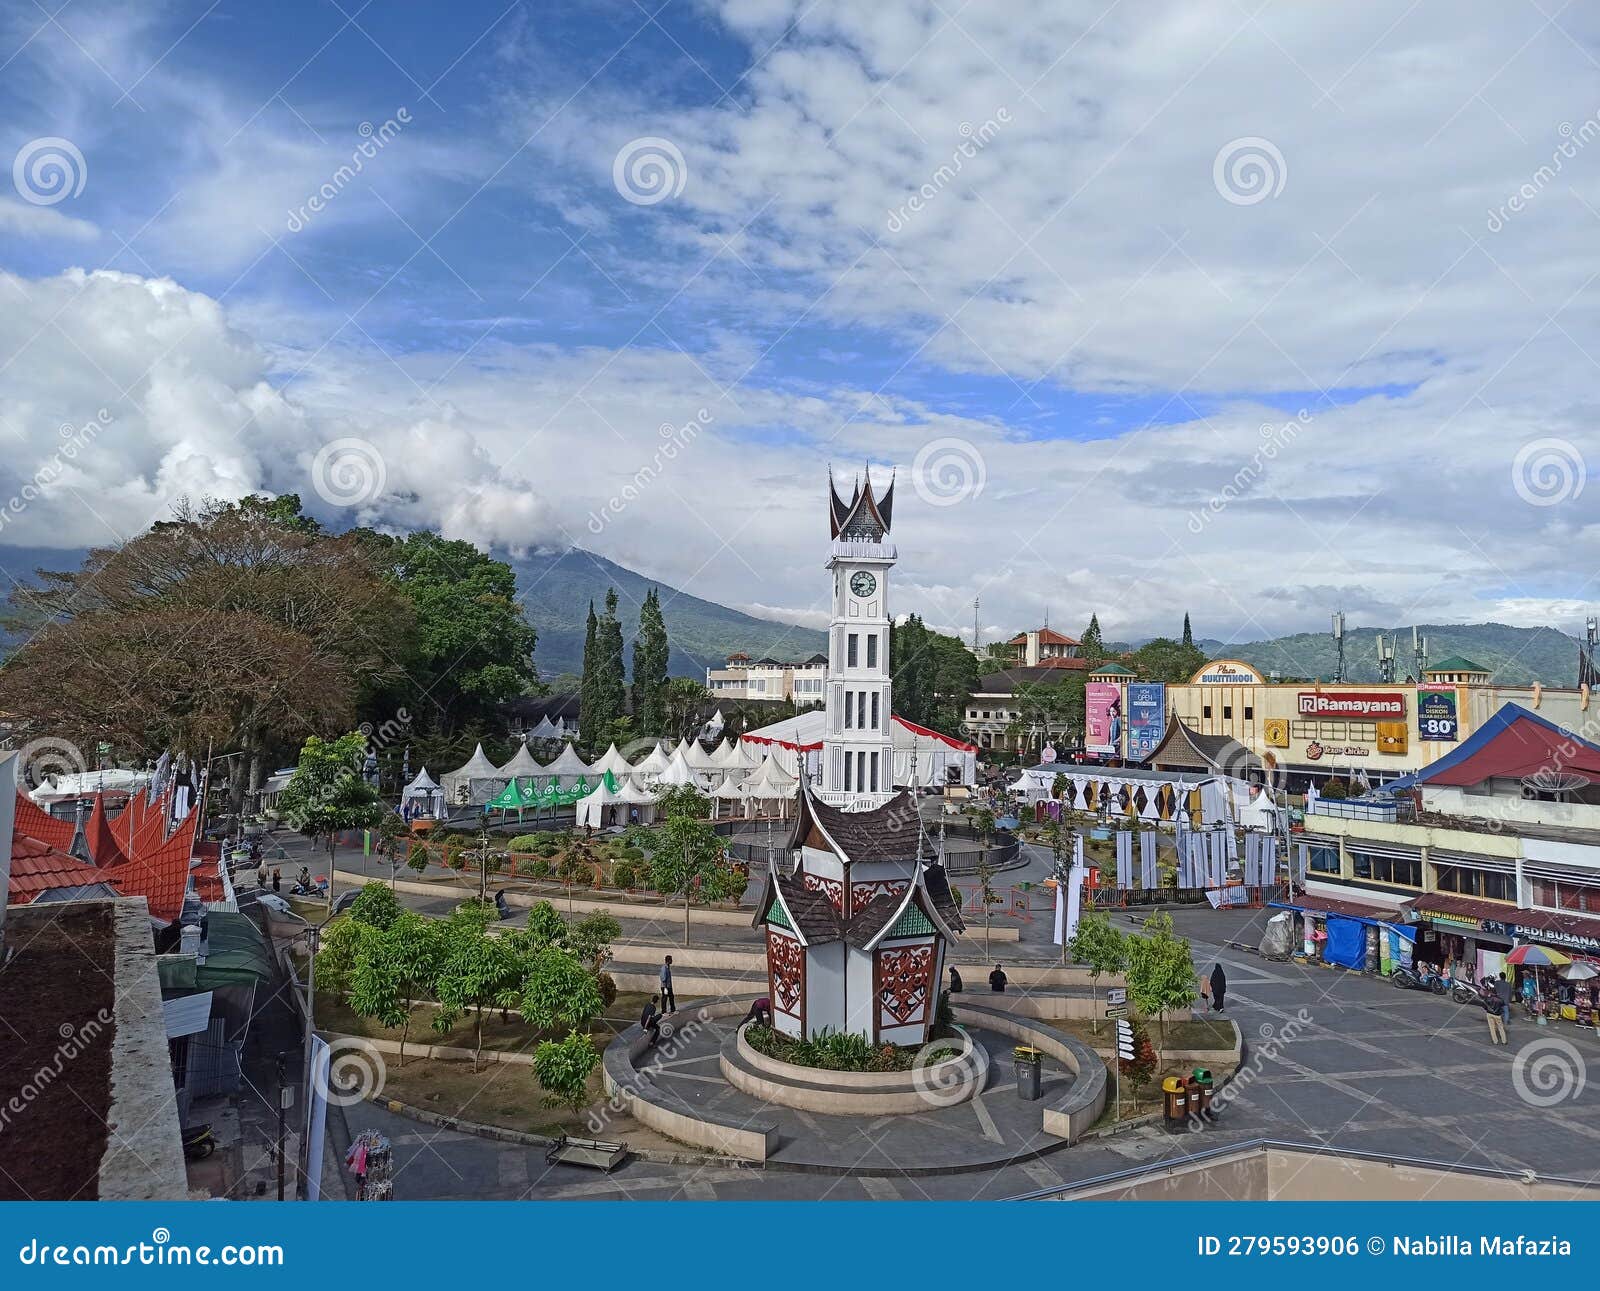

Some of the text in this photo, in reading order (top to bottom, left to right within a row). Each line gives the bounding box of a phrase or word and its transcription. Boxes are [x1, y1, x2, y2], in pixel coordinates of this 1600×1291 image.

[1317, 697, 1401, 713] Ramayana
[1383, 736, 1404, 744] ZONE
[1343, 746, 1369, 756] Chicken
[1515, 925, 1543, 936] DEDI
[1546, 929, 1599, 946] BUSANA
